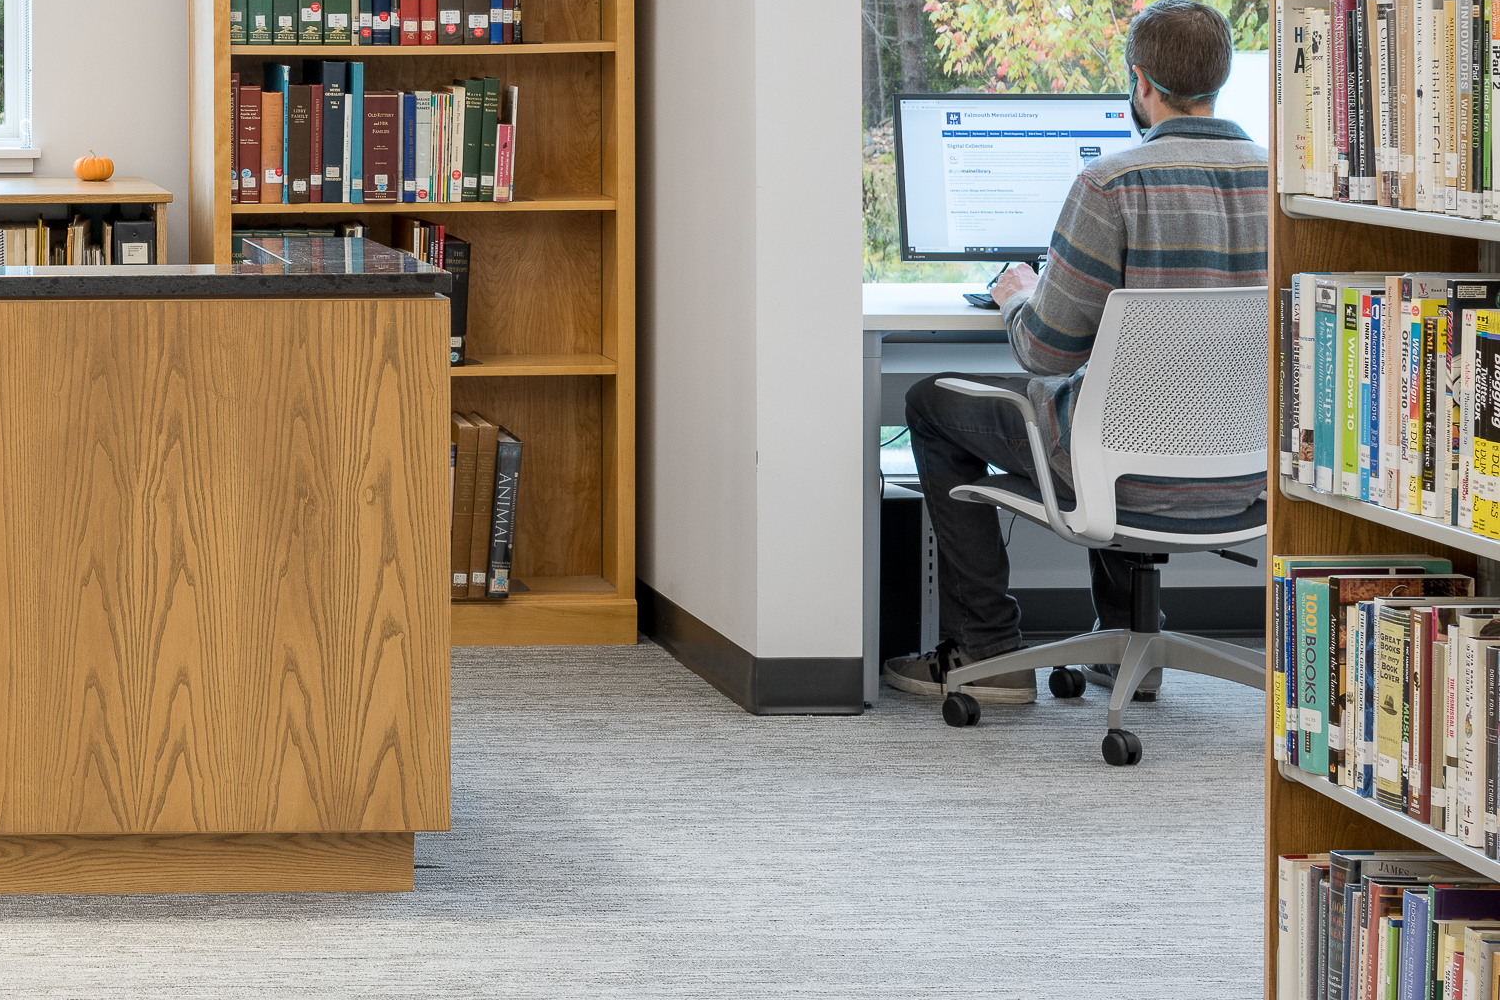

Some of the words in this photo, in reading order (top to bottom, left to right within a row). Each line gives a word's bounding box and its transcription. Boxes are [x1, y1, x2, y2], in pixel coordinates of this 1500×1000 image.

[1380, 27, 1388, 96] Outwitting
[1460, 5, 1469, 90] INNOVATORS
[1347, 72, 1356, 108] MONSTER
[1348, 109, 1356, 143] HUNTERS
[1380, 101, 1389, 149] History
[1460, 99, 1469, 137] Walter
[1460, 139, 1468, 191] Isaacson
[1401, 331, 1409, 372] Office
[1411, 338, 1419, 364] Web
[1426, 320, 1434, 353] HTML
[1324, 317, 1335, 426] JavaScript
[1347, 337, 1355, 408] Windows
[1410, 364, 1419, 404] Design
[1424, 353, 1433, 418] Programmer's
[1480, 367, 1488, 408] Twitter
[1347, 413, 1354, 431] 10
[1462, 392, 1471, 434] Photoshop
[1400, 413, 1409, 460] Simplified
[1424, 421, 1433, 467] Reference
[494, 473, 512, 547] ANIMAL
[1305, 593, 1317, 634] 1001
[1380, 633, 1401, 645] GREAT
[1381, 642, 1400, 654] BOOKS
[1304, 635, 1316, 704] BOOKS
[1380, 671, 1399, 683] LOVER
[1382, 662, 1398, 674] BOOK
[1379, 862, 1409, 875] JAMES
